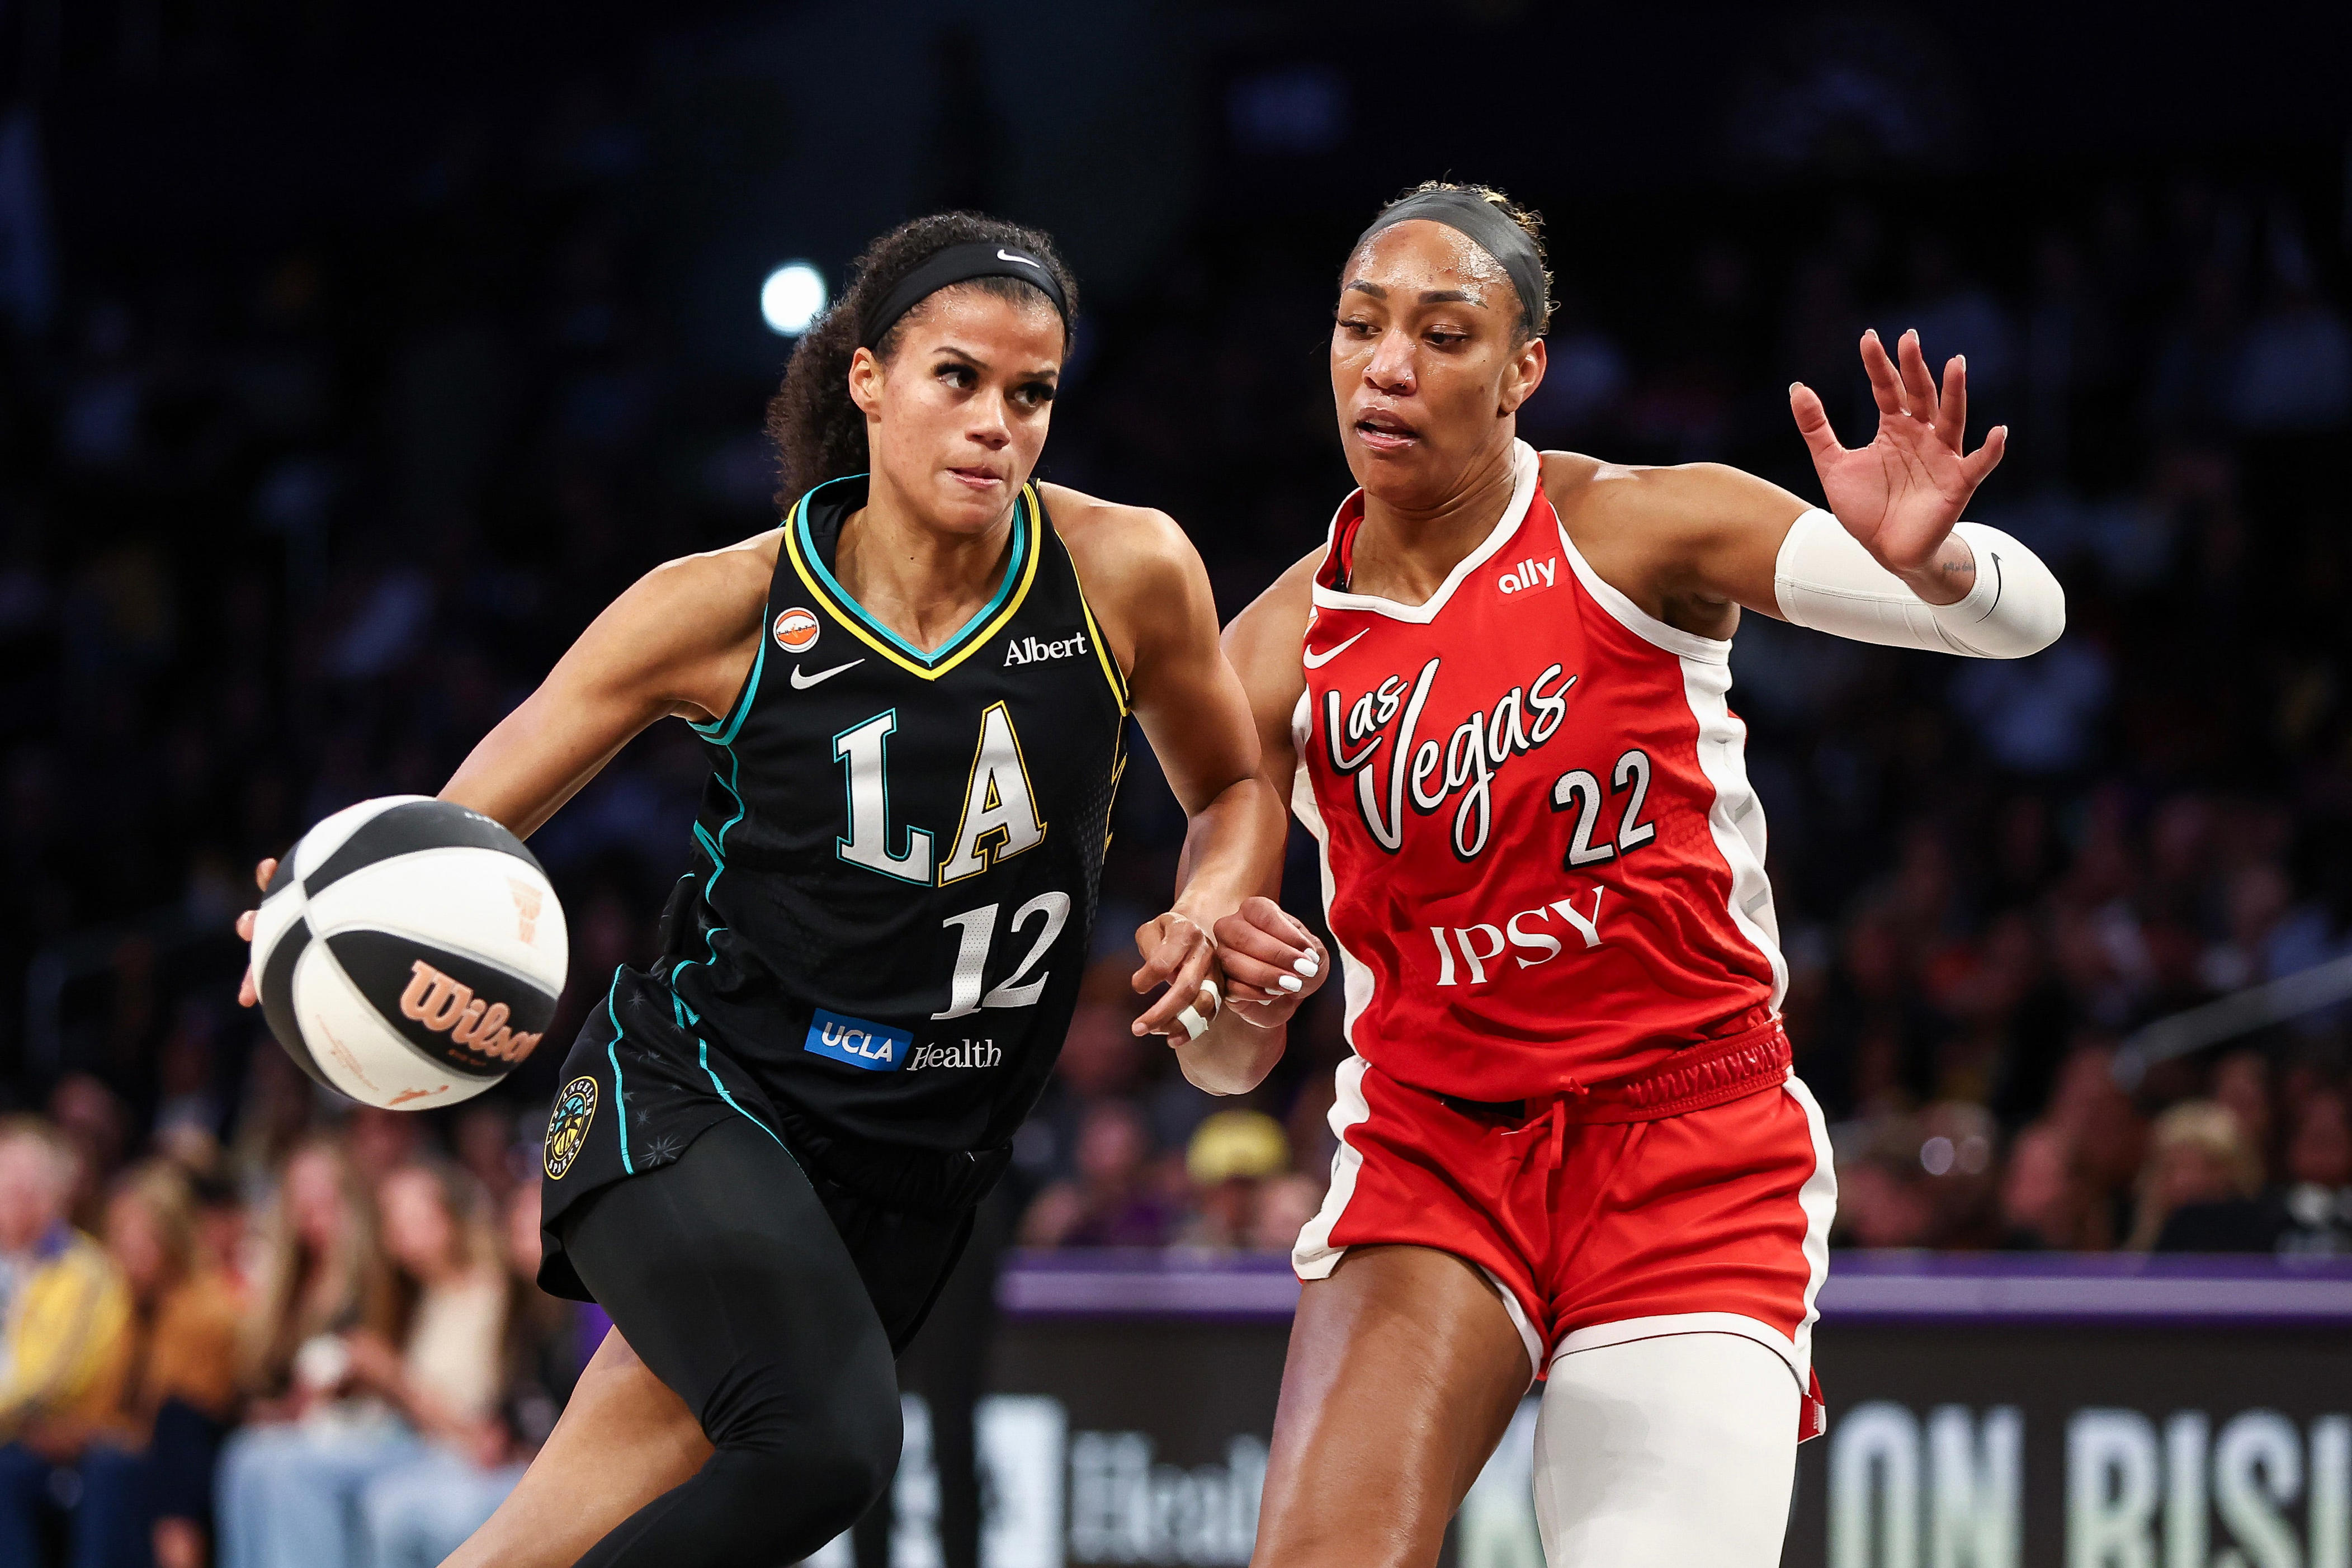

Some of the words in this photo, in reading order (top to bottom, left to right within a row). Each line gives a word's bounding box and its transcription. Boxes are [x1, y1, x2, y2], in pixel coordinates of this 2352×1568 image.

[1498, 557, 1556, 594] ally
[1004, 632, 1087, 667] Albert
[1324, 674, 1409, 775] Las
[1356, 657, 1578, 862] Vegas
[833, 700, 1047, 887] LA
[1551, 748, 1656, 871] 22
[931, 891, 1071, 1020] 12
[1430, 885, 1605, 986] IPSY
[821, 1021, 892, 1062] UCLA
[906, 1039, 1002, 1071] Health
[546, 1110, 559, 1145] LOS
[563, 1080, 594, 1117] ANGELES
[548, 1138, 580, 1174] SPARKS
